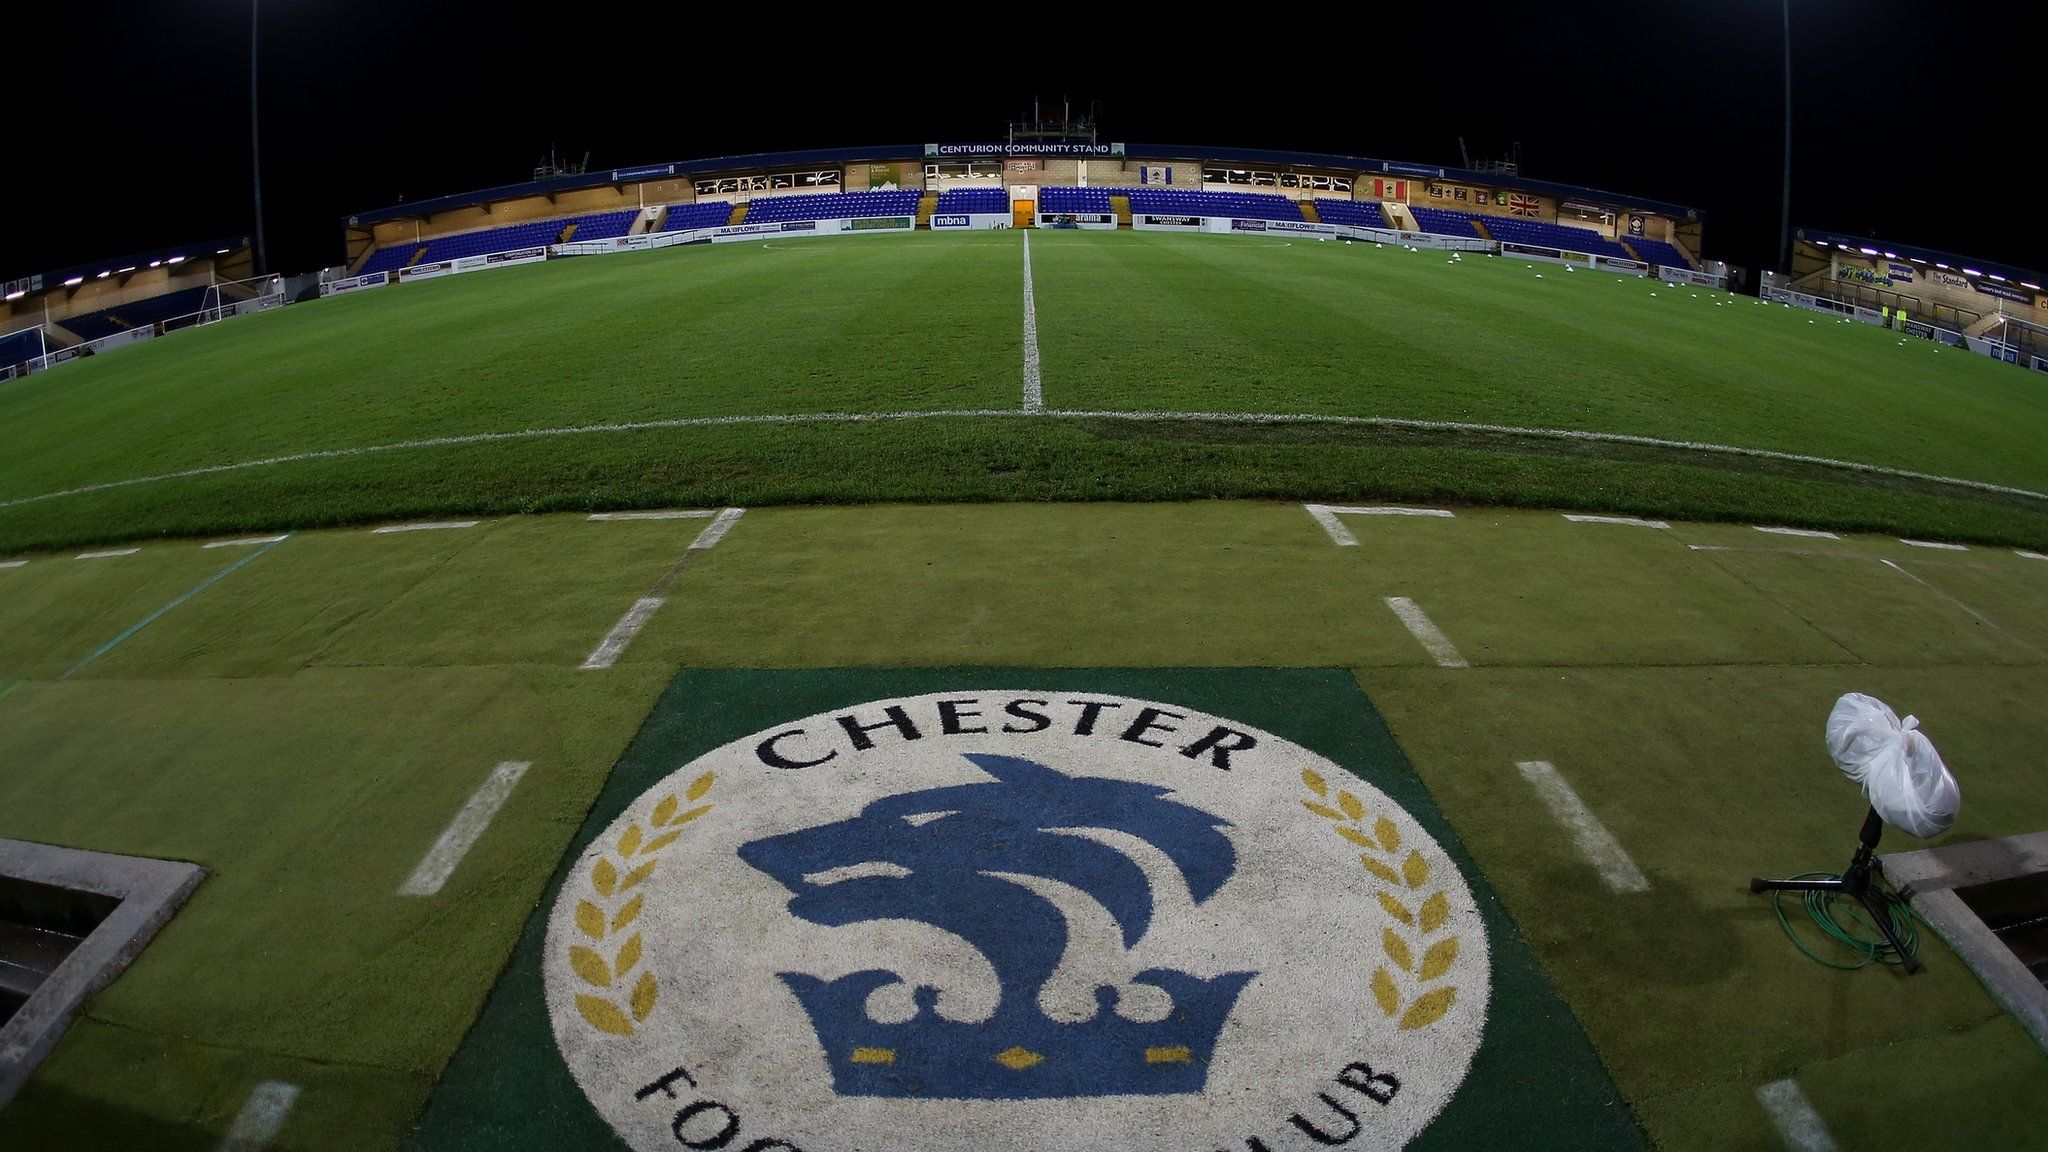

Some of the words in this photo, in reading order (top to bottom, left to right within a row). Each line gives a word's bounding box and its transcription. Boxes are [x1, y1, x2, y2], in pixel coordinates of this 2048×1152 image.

[940, 144, 1002, 154] CENTURION
[1004, 144, 1070, 154] COMMUNITY
[1072, 144, 1109, 153] STAND
[937, 215, 966, 226] mbna
[1933, 272, 1942, 281] The
[1941, 274, 1969, 289] Standard
[1904, 321, 1933, 333] WANSWAY
[757, 699, 1260, 772] CHESTER
